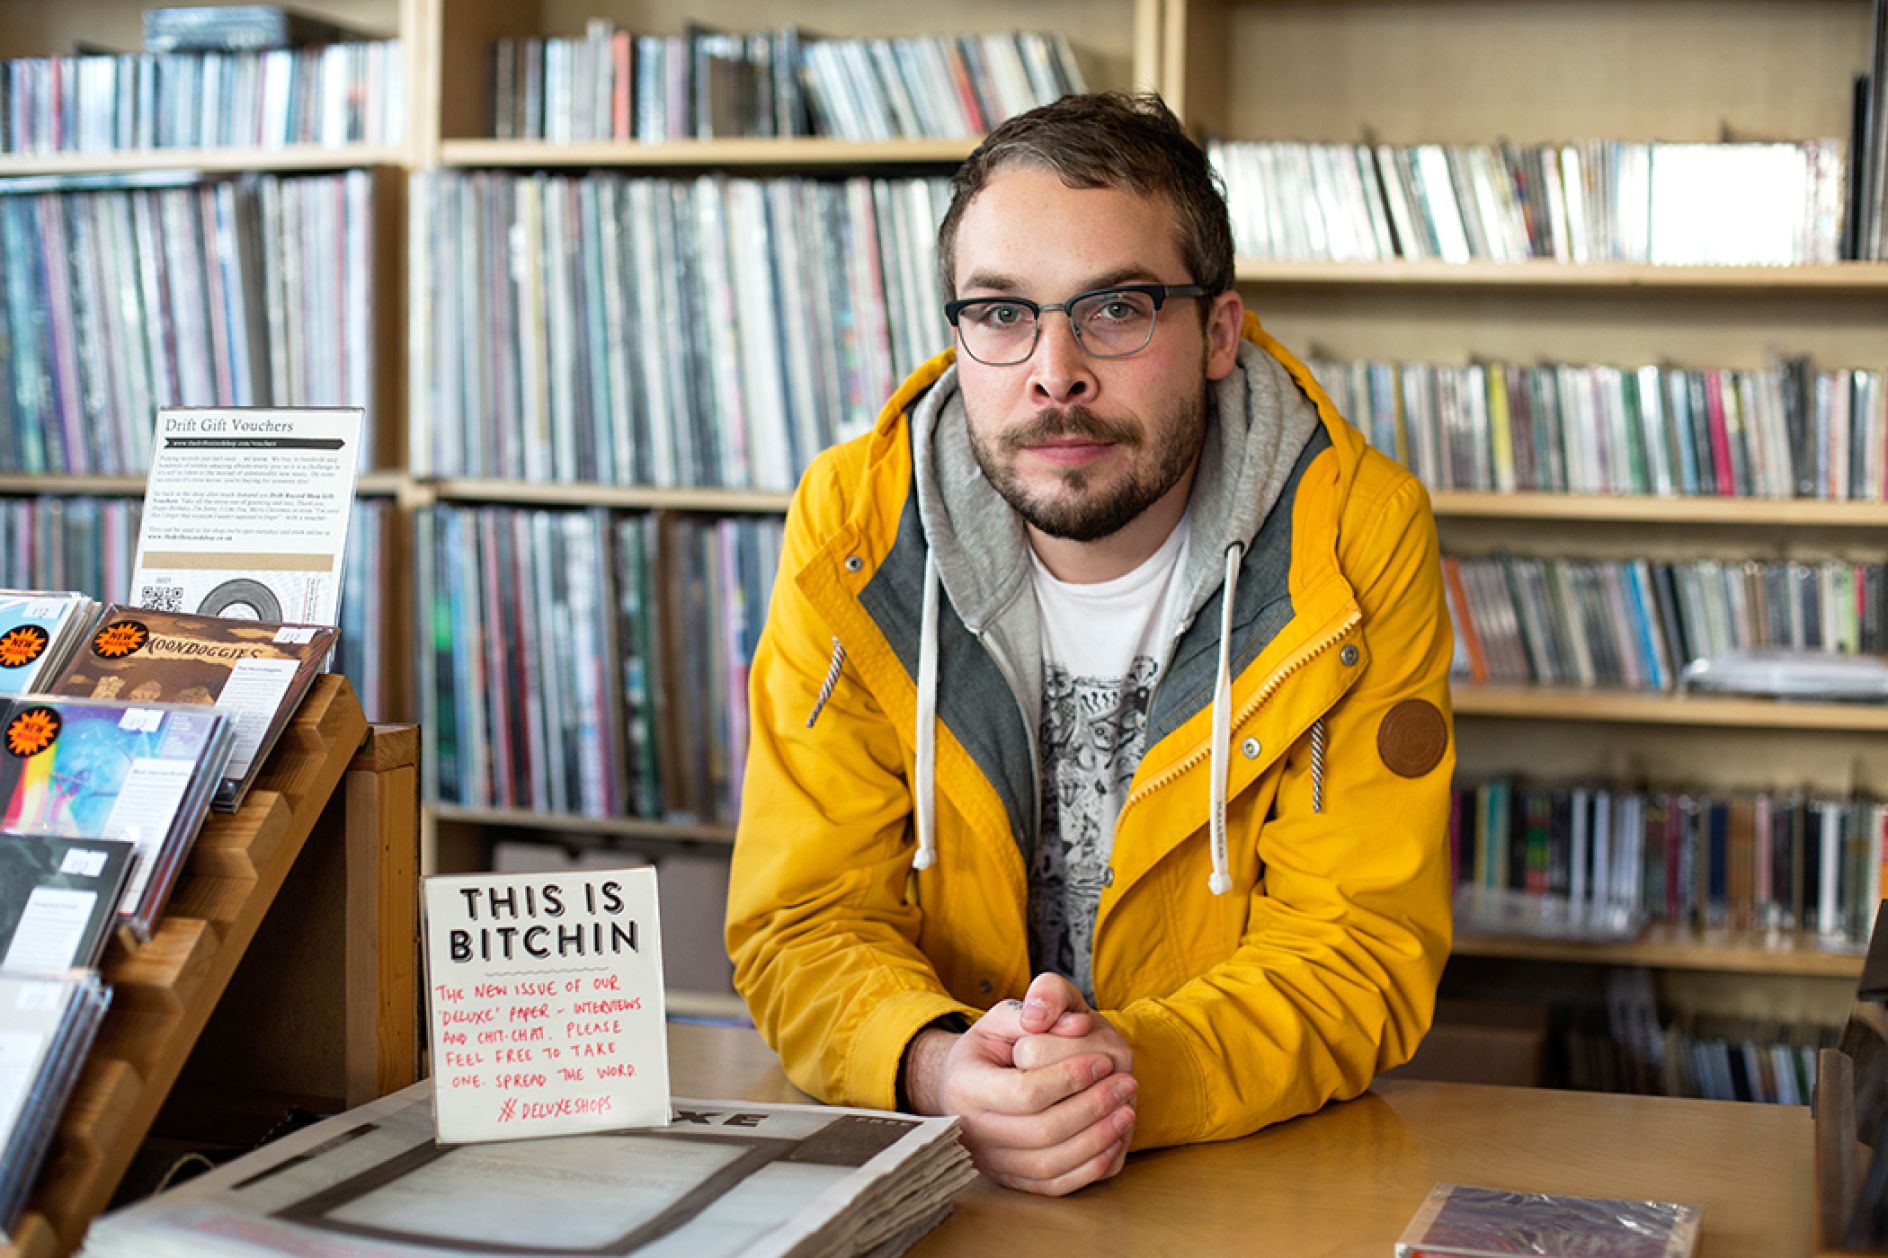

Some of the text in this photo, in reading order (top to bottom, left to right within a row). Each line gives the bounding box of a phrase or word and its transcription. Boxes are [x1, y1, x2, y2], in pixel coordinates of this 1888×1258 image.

[165, 418, 294, 432] Drift Gift Vouchers
[460, 881, 624, 921] THIS IS
[450, 920, 639, 963] BITCHIN
[436, 974, 621, 1005] THE NEW ISSUE OF OUR
[509, 1002, 550, 1023] PAPER
[573, 996, 641, 1015] INTERVIEWS
[442, 1031, 467, 1046] AND
[566, 1021, 621, 1039] PLEASE
[445, 1041, 615, 1068] FEEL FREE TO TAKE
[496, 1073, 547, 1090] SPREAD
[558, 1067, 584, 1082] THE
